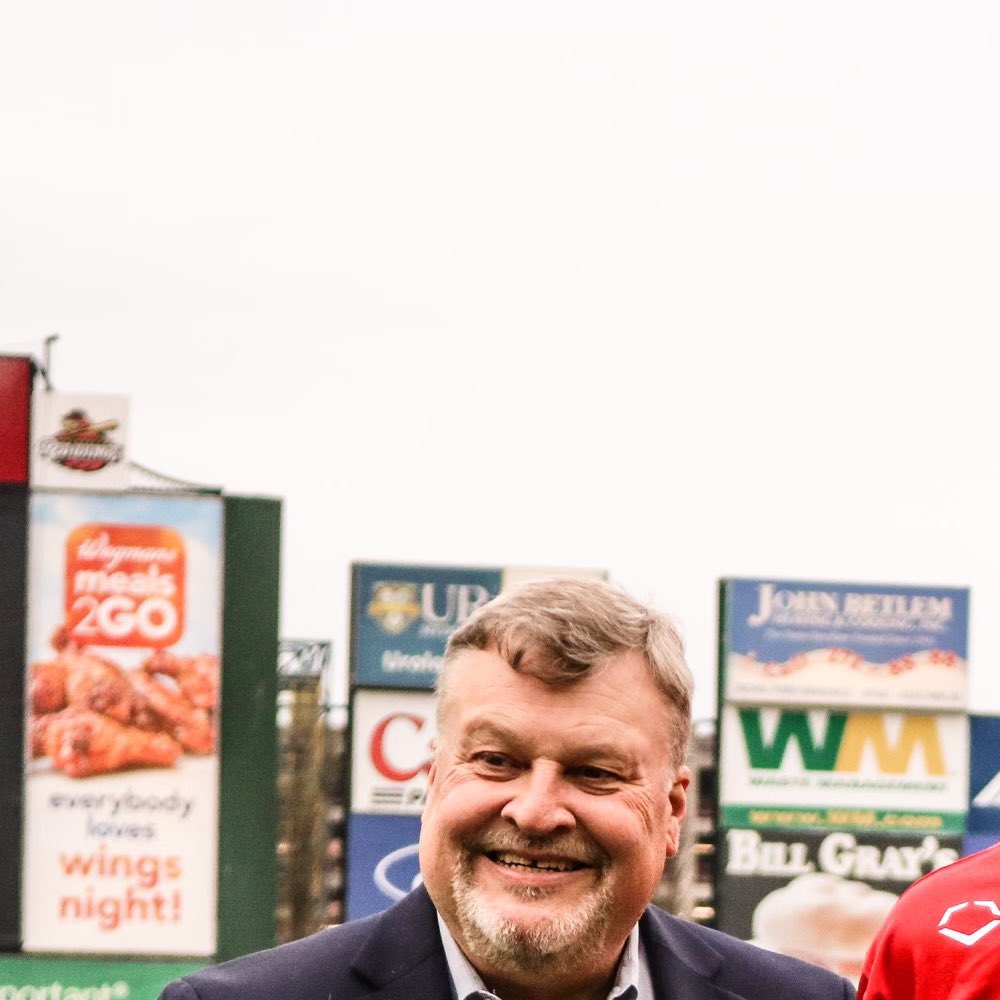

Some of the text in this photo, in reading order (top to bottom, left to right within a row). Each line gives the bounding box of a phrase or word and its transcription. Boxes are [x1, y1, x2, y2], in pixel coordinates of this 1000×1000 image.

[74, 567, 177, 598] meals
[73, 595, 178, 640] 2GO
[738, 708, 948, 776] WM
[48, 791, 195, 818] everybody
[87, 816, 156, 838] loves
[58, 843, 183, 889] wings
[725, 828, 815, 875] BILL
[59, 888, 183, 932] night!
